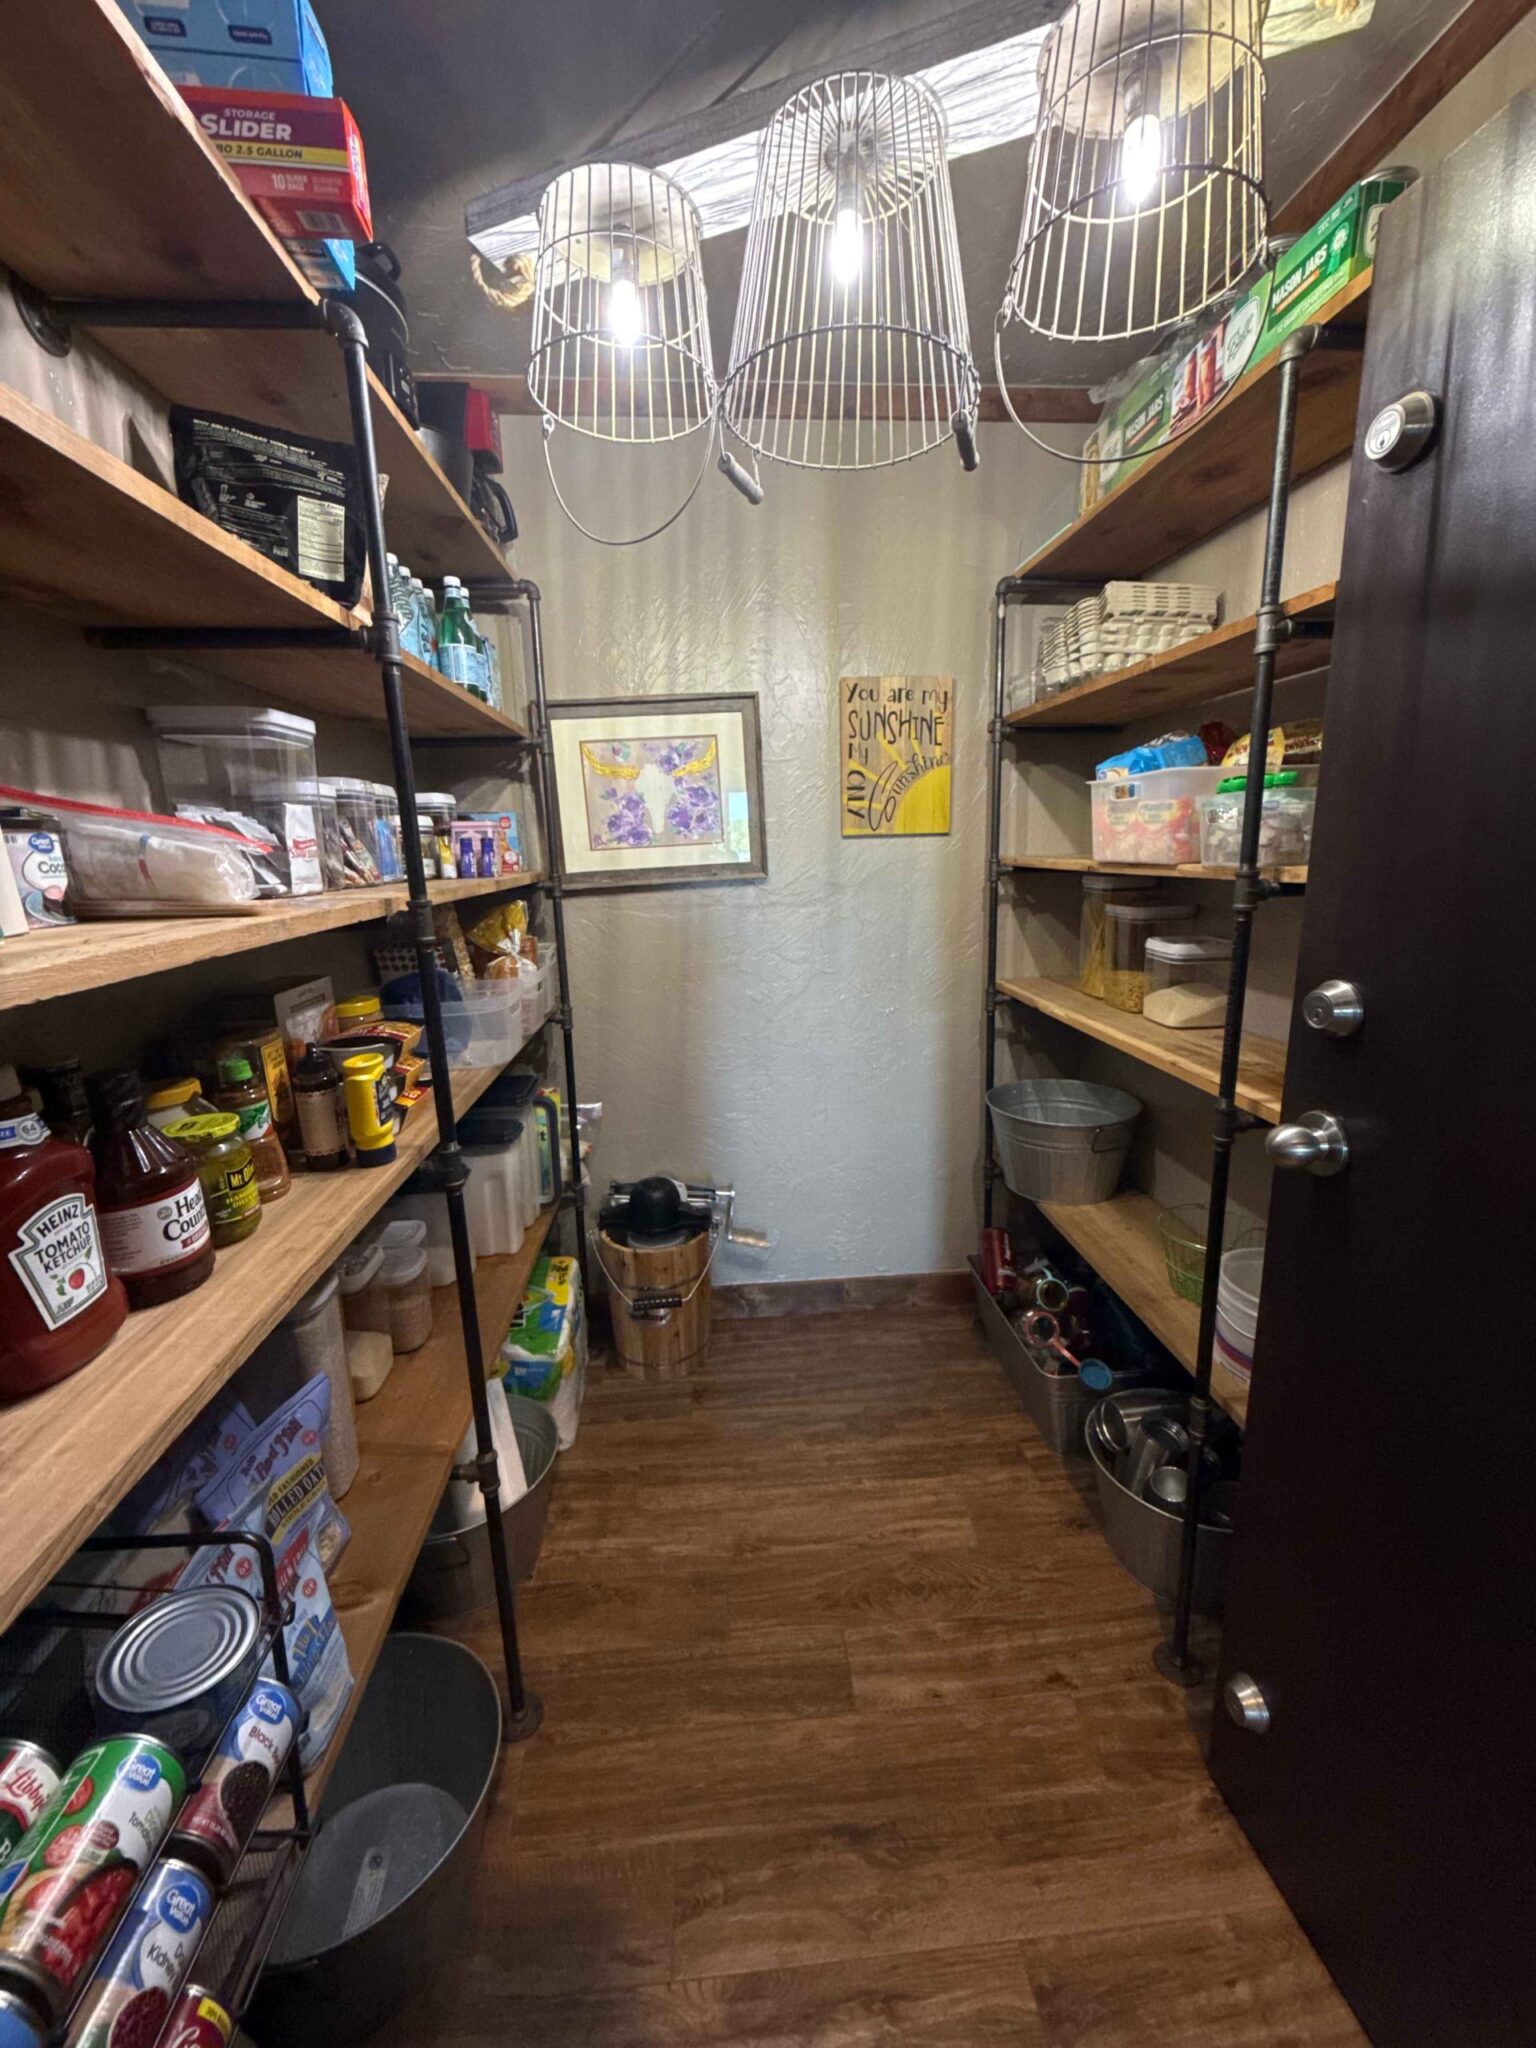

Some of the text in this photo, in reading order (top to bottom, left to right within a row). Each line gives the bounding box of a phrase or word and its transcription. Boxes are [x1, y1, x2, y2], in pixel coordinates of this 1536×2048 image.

[201, 113, 292, 141] SLIDER
[224, 108, 275, 121] STORAGE
[236, 144, 251, 156] 2.5
[256, 147, 303, 159] GALLON
[271, 173, 285, 190] 10
[1272, 267, 1303, 309] MASON
[1303, 243, 1328, 281] JARS
[1147, 393, 1164, 422] JARS
[887, 688, 914, 703] are
[922, 689, 948, 714] my
[848, 704, 945, 747] SUNSHINE
[21, 1123, 37, 1135] 64
[36, 1204, 79, 1239] HEINZ
[34, 1221, 90, 1264] TOMATO
[43, 1234, 92, 1274] KETCHUP
[256, 1694, 282, 1714] Great
[259, 1703, 279, 1721] Value
[248, 1726, 274, 1749] Black
[130, 1758, 155, 1780] Great
[167, 1888, 196, 1914] Great
[169, 1904, 191, 1928] Value
